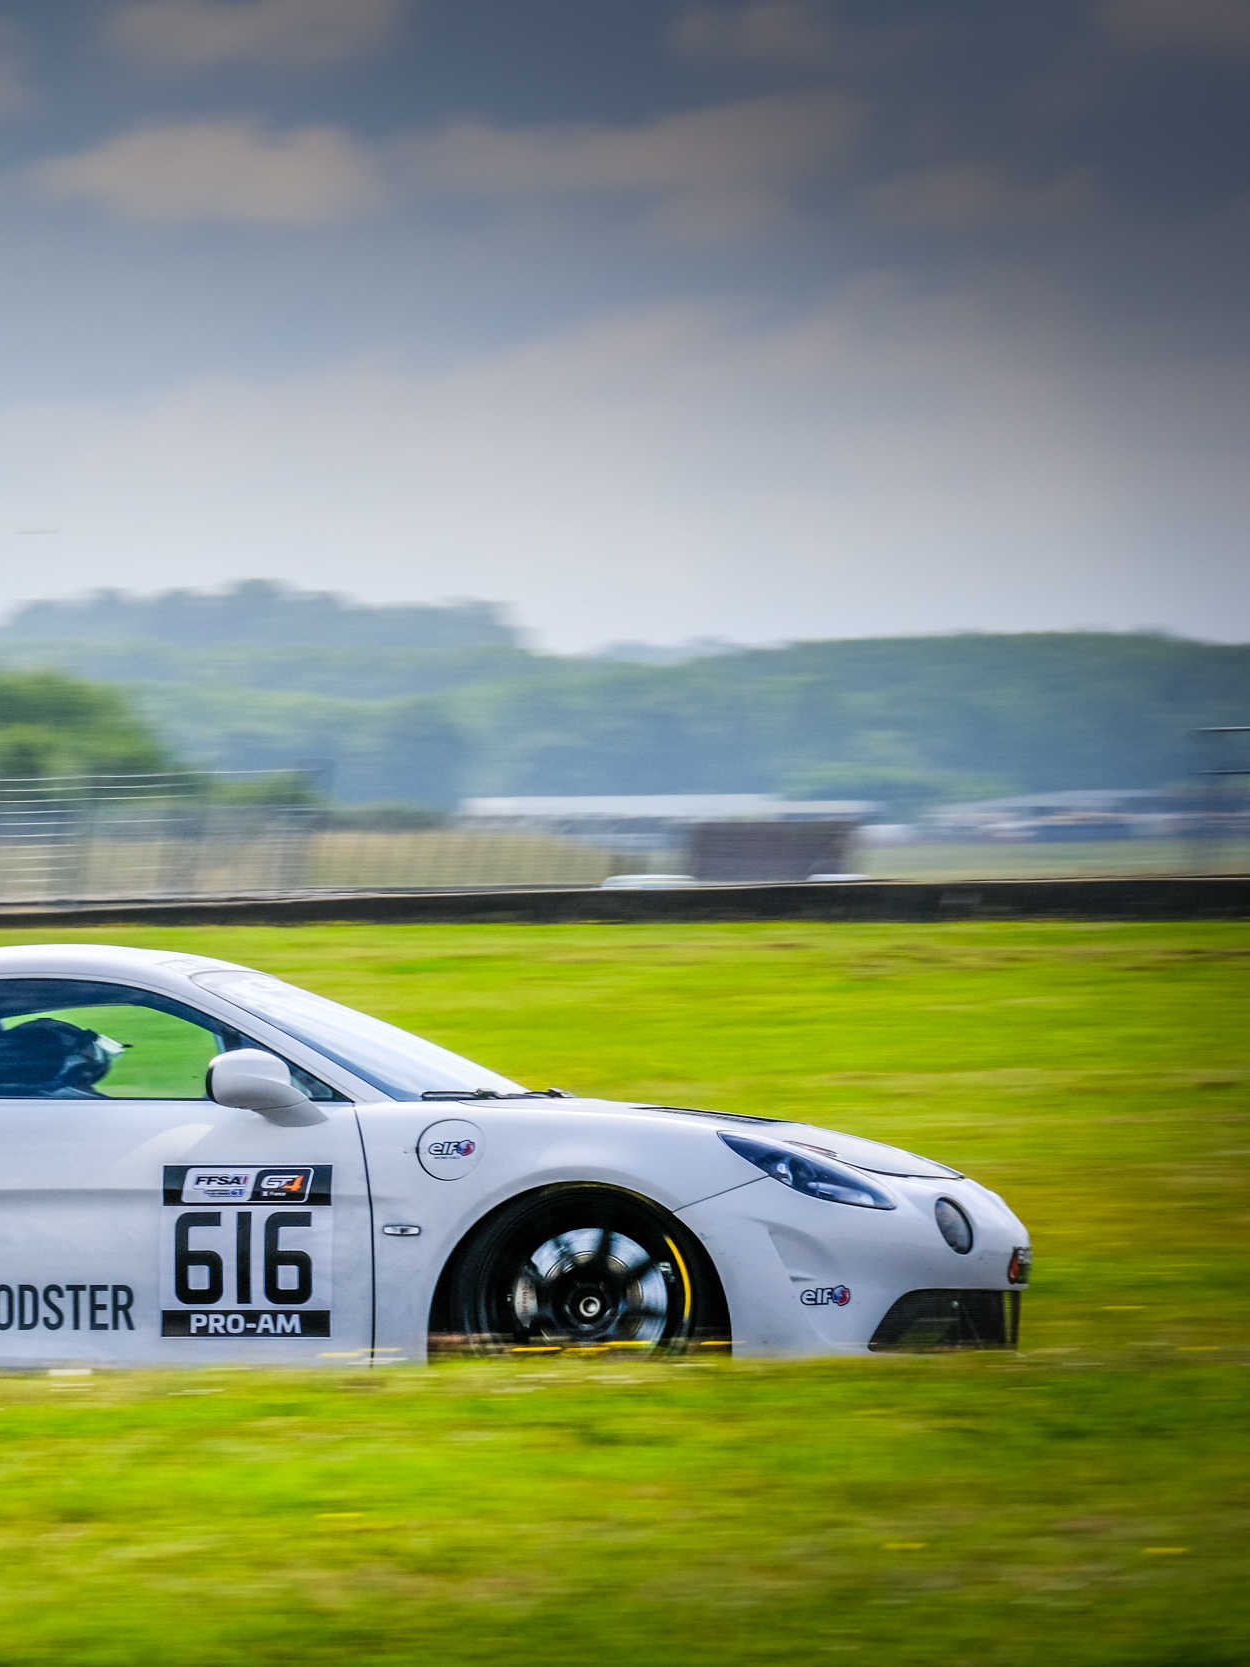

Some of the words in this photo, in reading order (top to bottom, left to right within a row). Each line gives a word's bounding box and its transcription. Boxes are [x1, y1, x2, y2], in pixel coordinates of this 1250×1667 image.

[428, 1141, 459, 1156] elf
[196, 1175, 242, 1186] FFSA
[260, 1174, 304, 1192] GT4
[174, 1211, 313, 1305] 616
[800, 1287, 833, 1306] elf
[189, 1313, 302, 1334] PRO-AM
